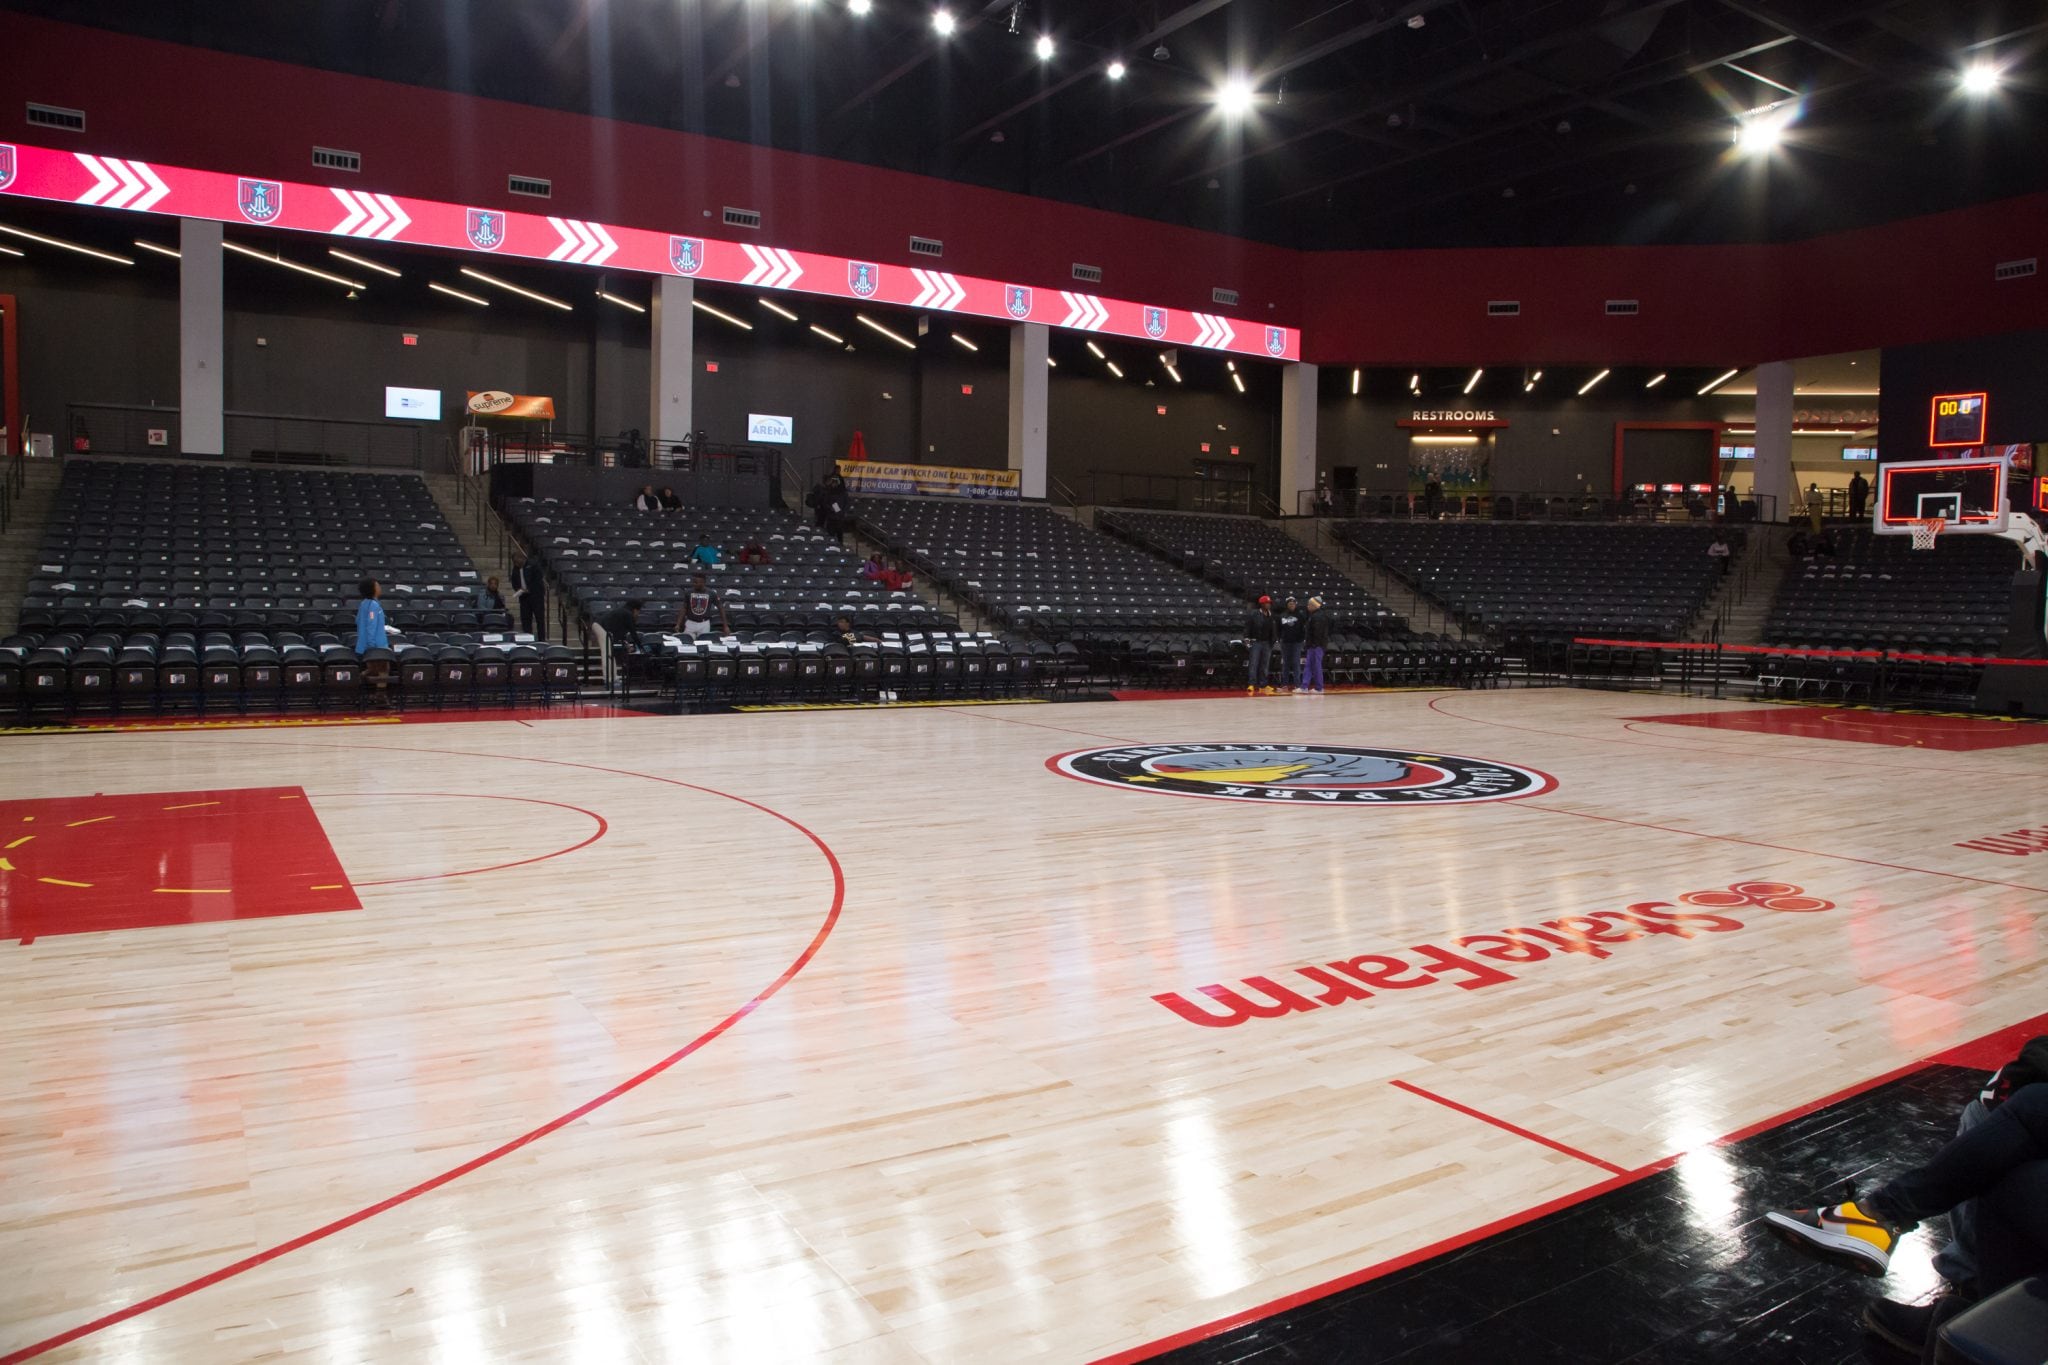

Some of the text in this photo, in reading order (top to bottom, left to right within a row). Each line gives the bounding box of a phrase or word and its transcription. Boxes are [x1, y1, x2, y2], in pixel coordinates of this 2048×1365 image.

[474, 397, 511, 410] supreme
[1413, 411, 1495, 420] RESTROOMS
[752, 425, 788, 437] ARENA
[884, 467, 900, 475] CAR
[932, 470, 948, 479] ONE
[878, 481, 912, 489] COLLECTED
[1214, 767, 1512, 799] COLLEGE PARK
